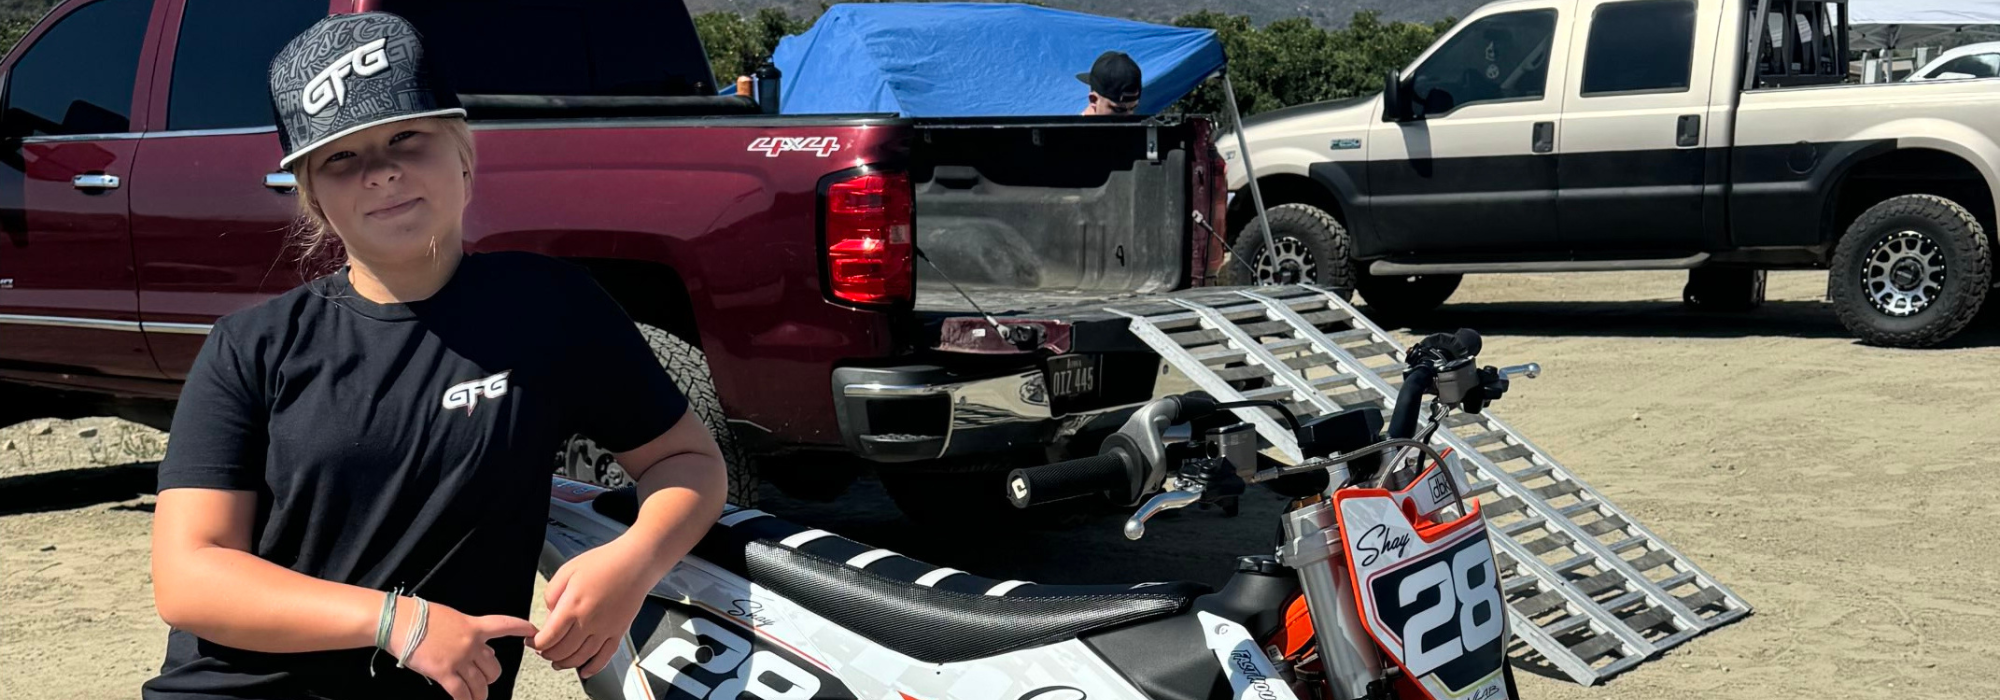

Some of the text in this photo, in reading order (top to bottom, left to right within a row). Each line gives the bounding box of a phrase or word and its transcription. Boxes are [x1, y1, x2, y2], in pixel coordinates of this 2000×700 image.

[302, 36, 391, 116] GFG
[442, 369, 512, 417] GFG
[1074, 366, 1094, 393] 445
[1356, 523, 1411, 567] Shay
[1398, 539, 1504, 678] 28
[638, 617, 821, 700] 28
